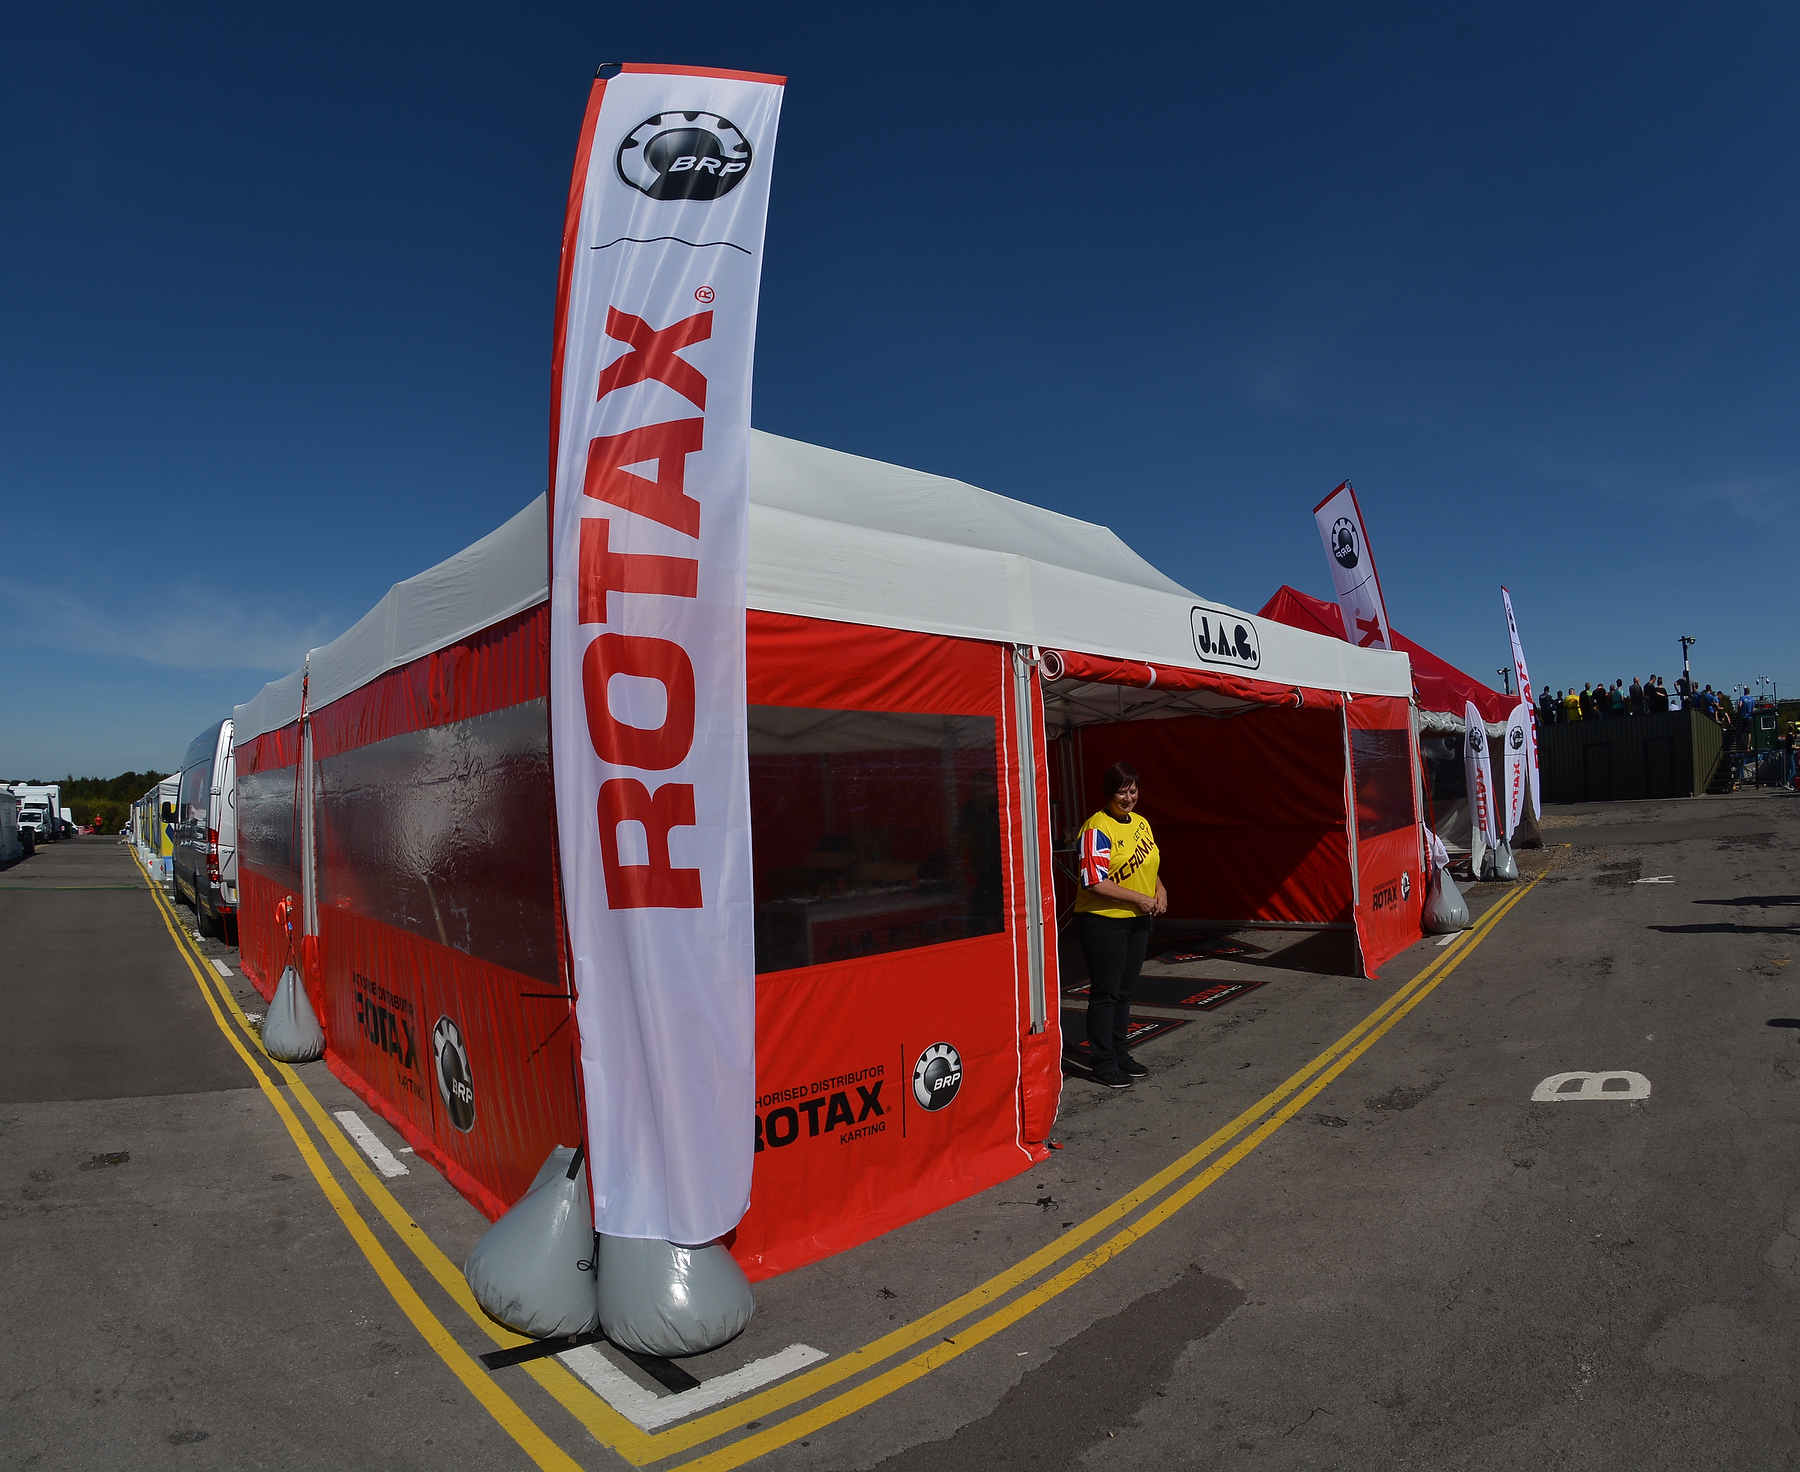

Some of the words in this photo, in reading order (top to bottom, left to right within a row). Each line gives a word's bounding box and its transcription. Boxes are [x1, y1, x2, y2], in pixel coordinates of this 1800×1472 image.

[669, 156, 746, 177] BRP
[1373, 885, 1398, 912] ROTAX
[354, 989, 420, 1076] ROTAX
[452, 1080, 473, 1104] BRP
[811, 1064, 885, 1095] DISTRIBUTOR
[933, 1072, 962, 1092] BRP
[1531, 1070, 1651, 1102] B
[840, 1121, 886, 1146] KARTING
